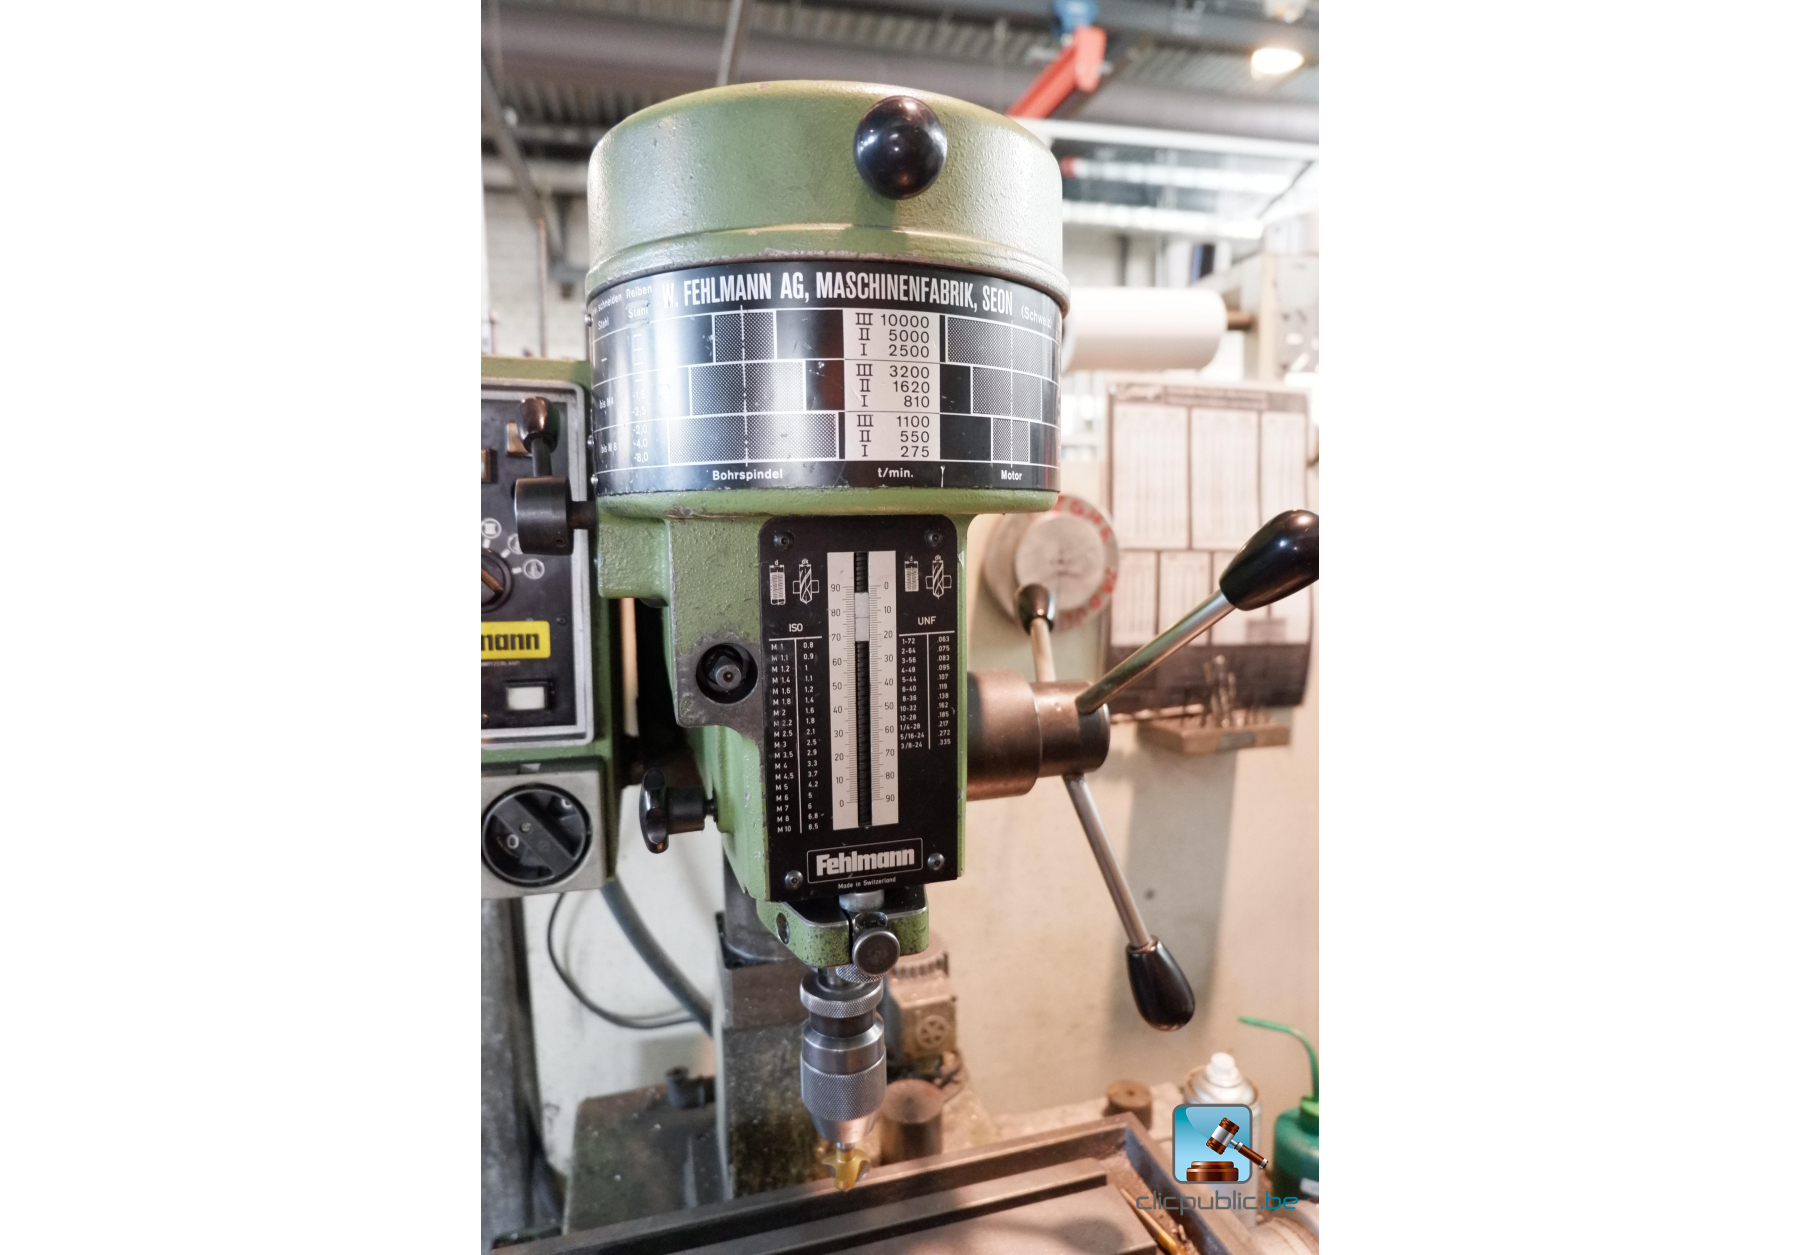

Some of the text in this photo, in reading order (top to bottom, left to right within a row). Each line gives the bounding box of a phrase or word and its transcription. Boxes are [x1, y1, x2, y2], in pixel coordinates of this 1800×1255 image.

[626, 286, 652, 299] Reiben
[684, 273, 771, 306] FEHLMANN
[781, 272, 809, 302] AG,
[816, 272, 977, 312] MASCHINENFABRIK,
[983, 285, 1013, 315] SEON
[856, 313, 929, 328] III 10000
[858, 328, 929, 343] II 5000
[860, 343, 929, 358] I 2500
[856, 364, 929, 378] III 3200
[860, 379, 930, 393] II 1620
[861, 395, 930, 408] I 810
[857, 415, 929, 428] III 1100
[860, 430, 929, 443] II 550
[862, 445, 929, 458] I 275
[713, 469, 783, 481] Bohrspindel
[878, 467, 914, 478] t/min.
[1001, 470, 1022, 481] Motor
[831, 584, 840, 592] 90
[918, 616, 936, 625] UNF
[789, 623, 803, 632] ISO
[833, 658, 842, 666] 60
[885, 654, 893, 662] 30
[833, 682, 842, 690] 50
[885, 678, 893, 686] 40
[885, 702, 893, 710] 50
[835, 753, 844, 761] 20
[816, 849, 915, 876] Fehlmann
[864, 877, 896, 886] Switzerland
